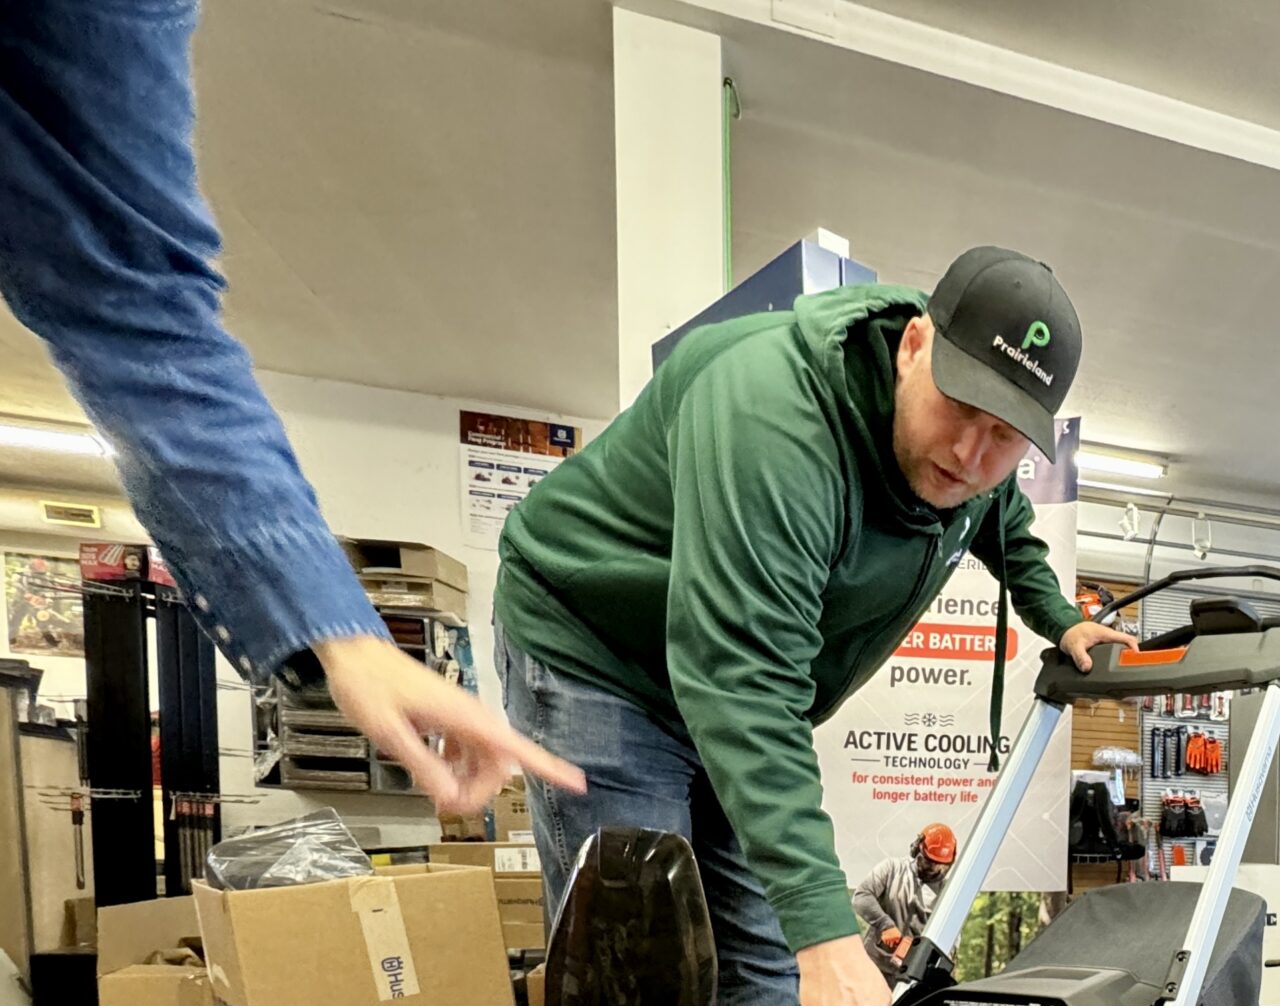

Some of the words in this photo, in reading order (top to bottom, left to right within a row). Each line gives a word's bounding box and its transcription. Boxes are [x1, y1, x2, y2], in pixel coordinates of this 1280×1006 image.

[993, 334, 1053, 386] Prairieland
[929, 633, 996, 651] BATTER
[890, 664, 972, 687] power.
[844, 731, 917, 751] ACTIVE
[925, 734, 1010, 754] COOLING
[883, 756, 970, 770] TECHNOLOGY
[852, 771, 869, 785] for
[872, 773, 933, 787] consistent
[937, 777, 974, 790] power
[872, 788, 910, 803] longer
[914, 790, 956, 804] battery
[960, 791, 978, 802] life
